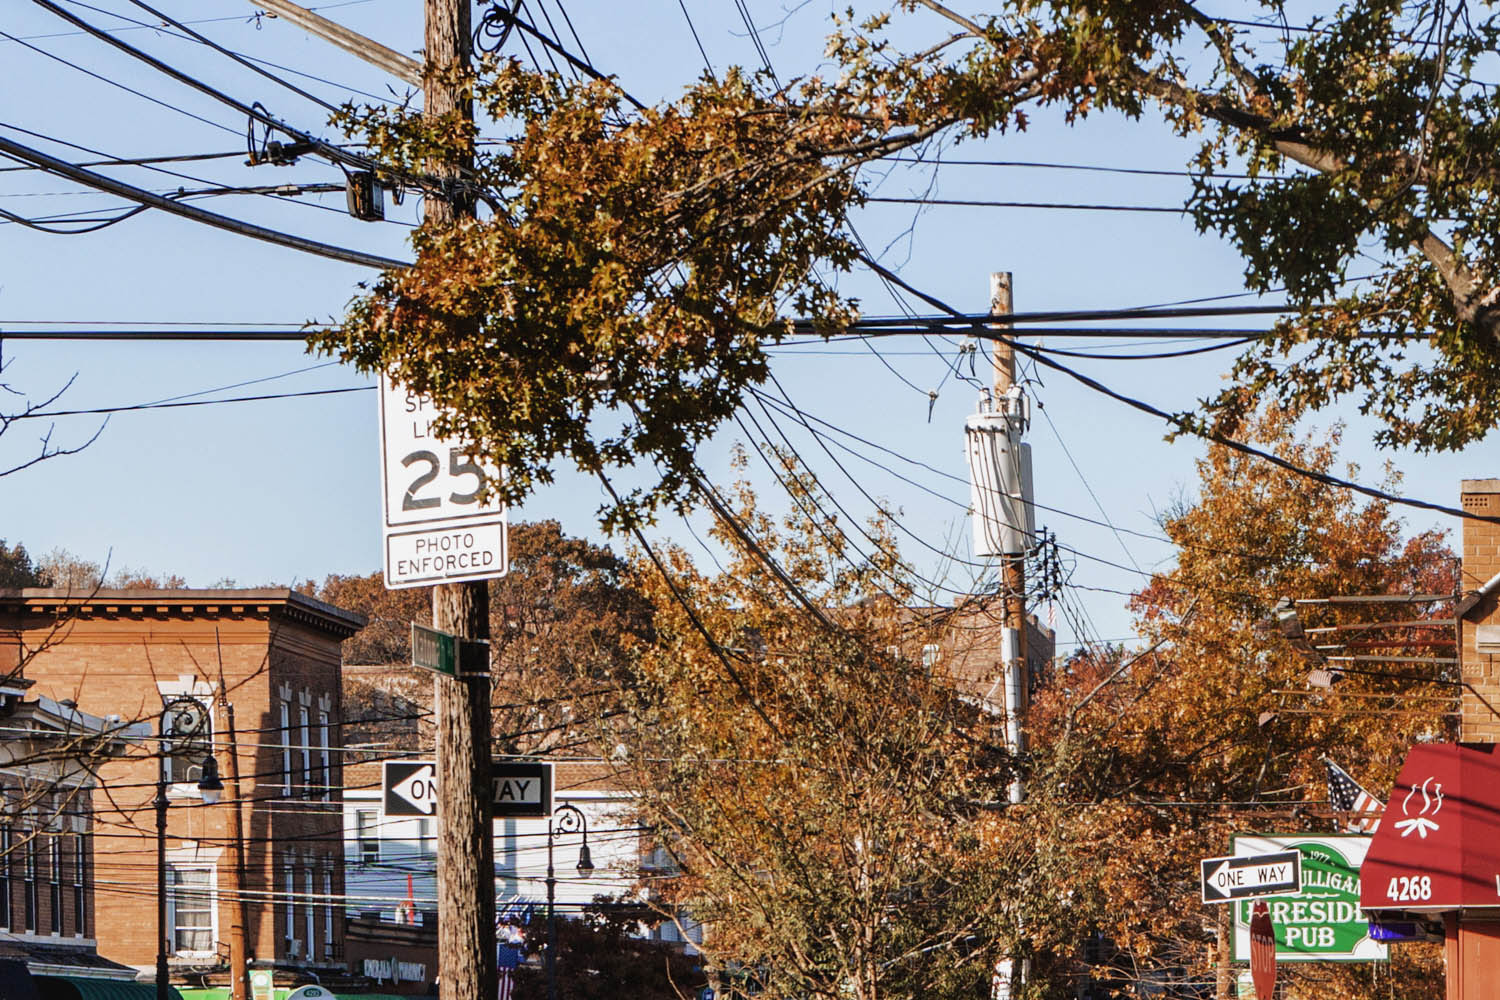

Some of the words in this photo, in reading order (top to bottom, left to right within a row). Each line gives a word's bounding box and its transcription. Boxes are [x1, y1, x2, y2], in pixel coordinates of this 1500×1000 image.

[401, 447, 488, 512] 25
[416, 533, 474, 554] PHOTO
[398, 550, 493, 575] ENFORCED
[411, 779, 438, 800] ON
[494, 779, 531, 801] AY
[1310, 850, 1331, 864] 1977
[1217, 870, 1244, 888] ONE
[1258, 865, 1287, 884] WAY
[1387, 875, 1432, 901] 4268
[1286, 926, 1336, 948] PUB
[1251, 931, 1273, 973] STOP
